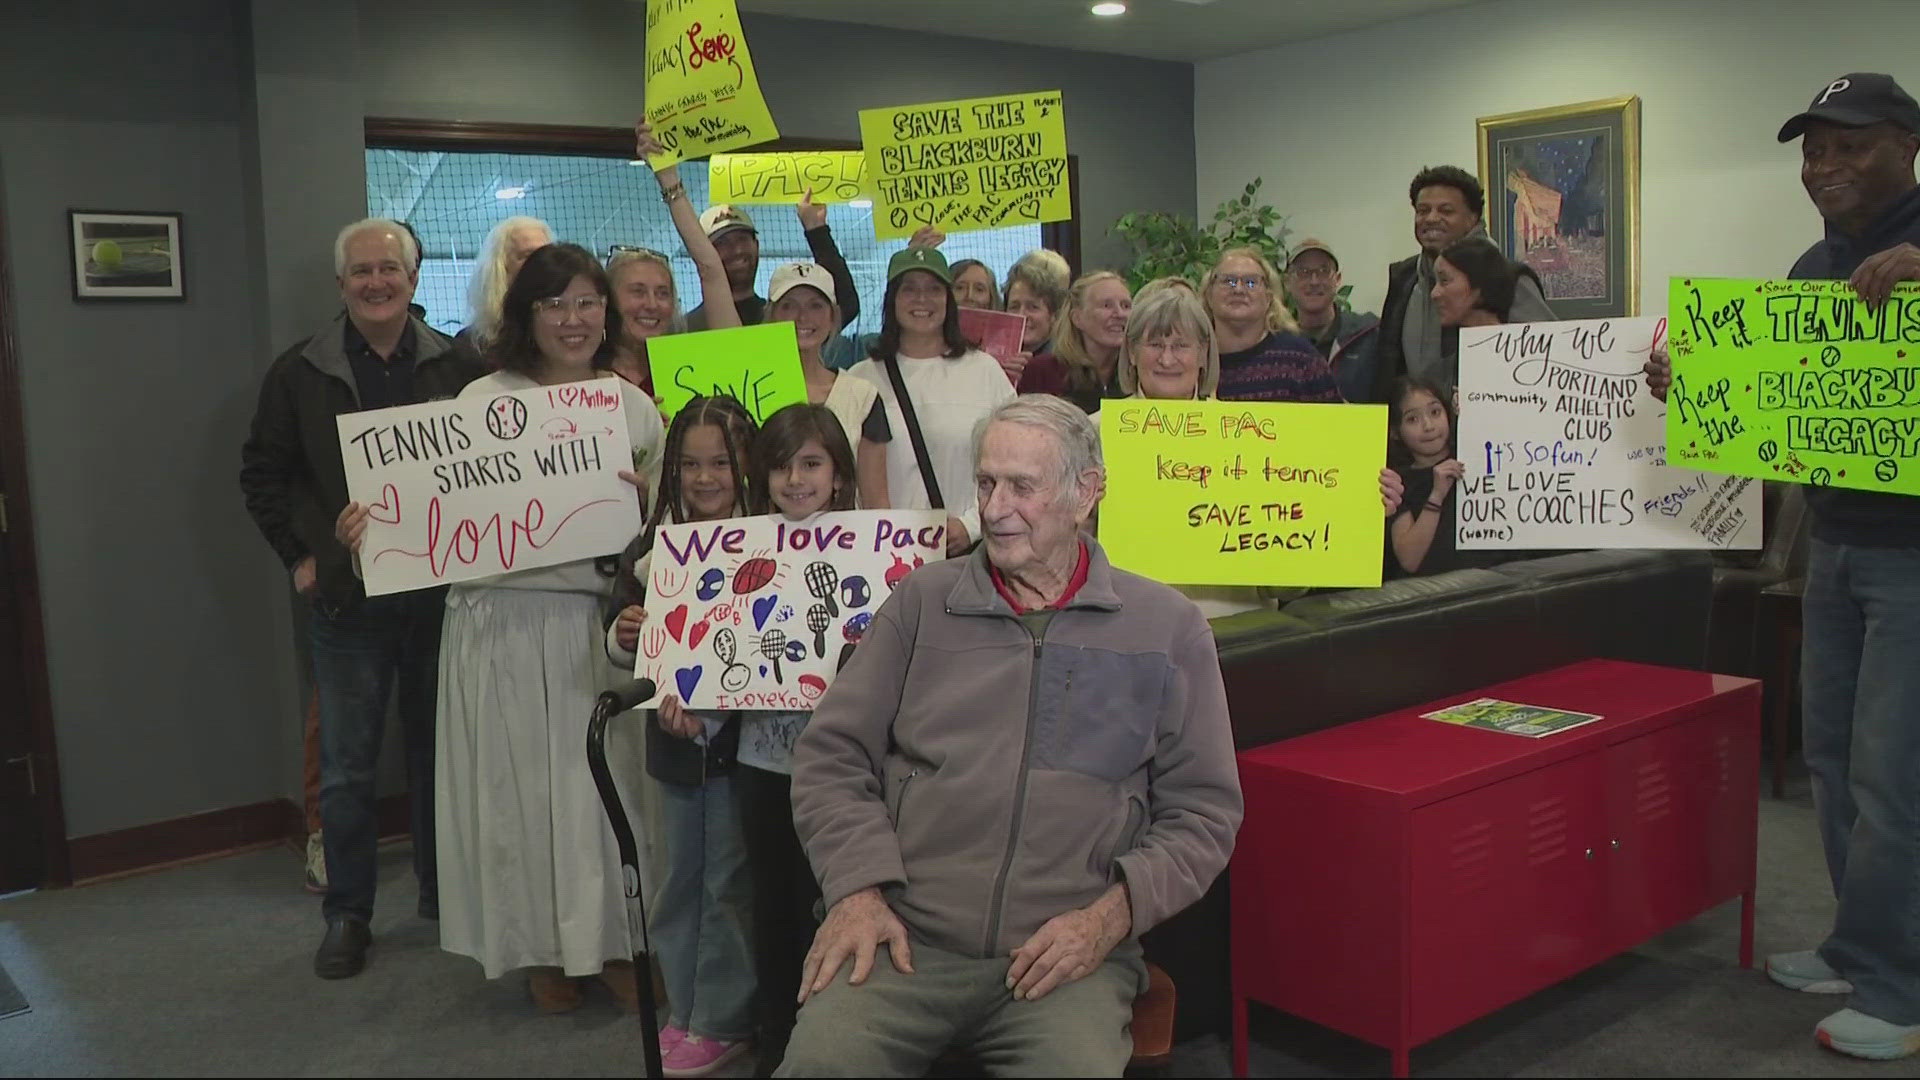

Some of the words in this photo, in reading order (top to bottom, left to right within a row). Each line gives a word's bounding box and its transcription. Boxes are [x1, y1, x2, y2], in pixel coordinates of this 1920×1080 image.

[1818, 78, 1852, 105] P
[699, 116, 726, 135] PAC
[893, 108, 962, 141] SAVE
[972, 101, 1025, 130] THE
[881, 132, 1042, 176] BLACKBURN
[728, 155, 865, 199] PAC!
[877, 169, 970, 206] TENNIS
[978, 158, 1065, 194] LEGACY
[951, 205, 973, 226] THE
[972, 194, 1001, 223] PAC
[990, 187, 1056, 226] COMMUNITY
[1764, 280, 1794, 293] Save
[1800, 281, 1826, 293] Our
[1685, 288, 1744, 348] Keep
[1766, 294, 1920, 344] TENNIS
[548, 390, 555, 409] I
[674, 365, 776, 421] SVE
[1548, 366, 1638, 399] PORTLAND
[1757, 367, 1920, 410] BLACKBU
[1467, 391, 1548, 413] community
[1672, 373, 1731, 431] Keep
[351, 412, 471, 470] TENNIS
[1119, 407, 1207, 437] SAVE
[1220, 411, 1277, 440] PAC
[1564, 417, 1613, 442] CLUB
[1787, 415, 1920, 458] LEGACY
[433, 451, 522, 494] STARTS
[534, 435, 601, 477] WITH
[1223, 455, 1248, 480] it
[1263, 457, 1340, 489] tennis
[1462, 475, 1496, 496] WE
[1508, 471, 1576, 492] LOVE
[1188, 504, 1252, 528] SAVE
[1261, 503, 1304, 521] THE
[1461, 497, 1507, 522] OUR
[405, 496, 575, 578] love
[660, 525, 746, 567] We
[776, 523, 857, 553] love
[716, 694, 729, 710] I
